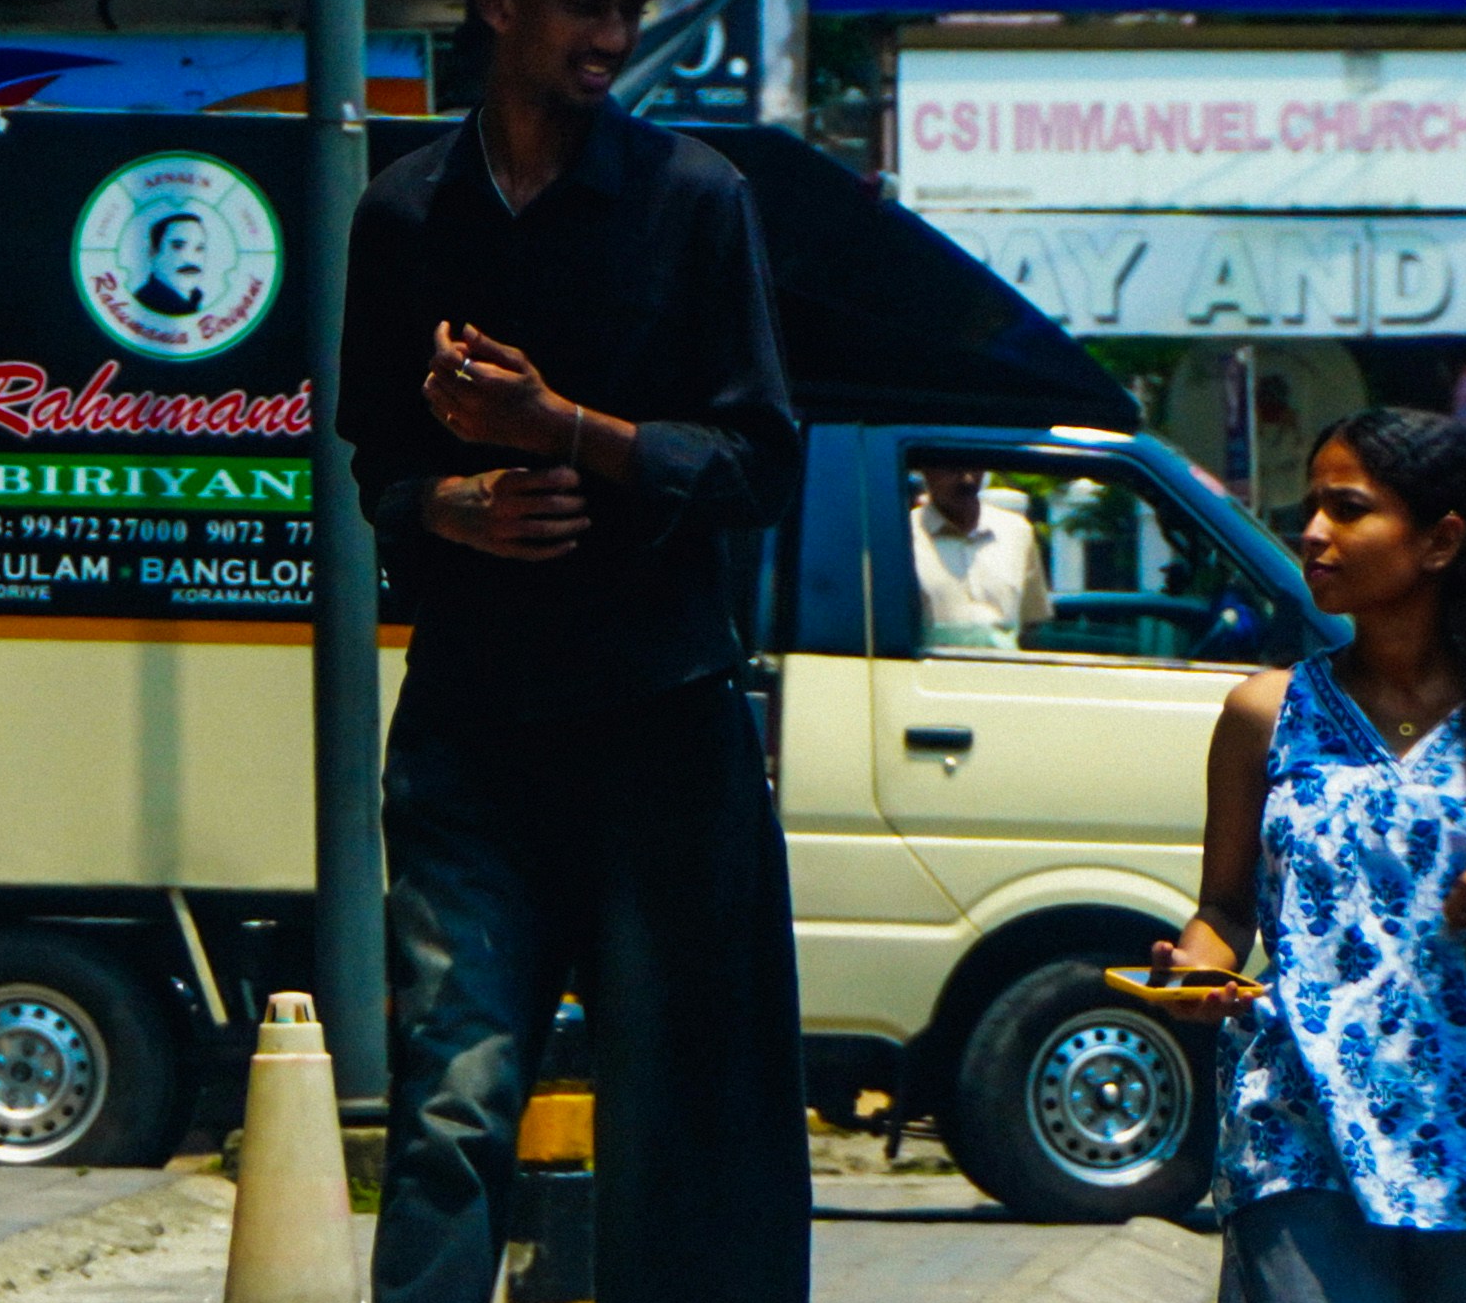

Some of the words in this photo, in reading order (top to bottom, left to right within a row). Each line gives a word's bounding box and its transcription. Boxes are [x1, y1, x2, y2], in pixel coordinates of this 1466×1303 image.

[1013, 103, 1272, 153] IMMANUEL
[1183, 229, 1454, 325] AND
[20, 515, 101, 541] 99472
[107, 517, 188, 543] 27000
[205, 520, 265, 543] 9072
